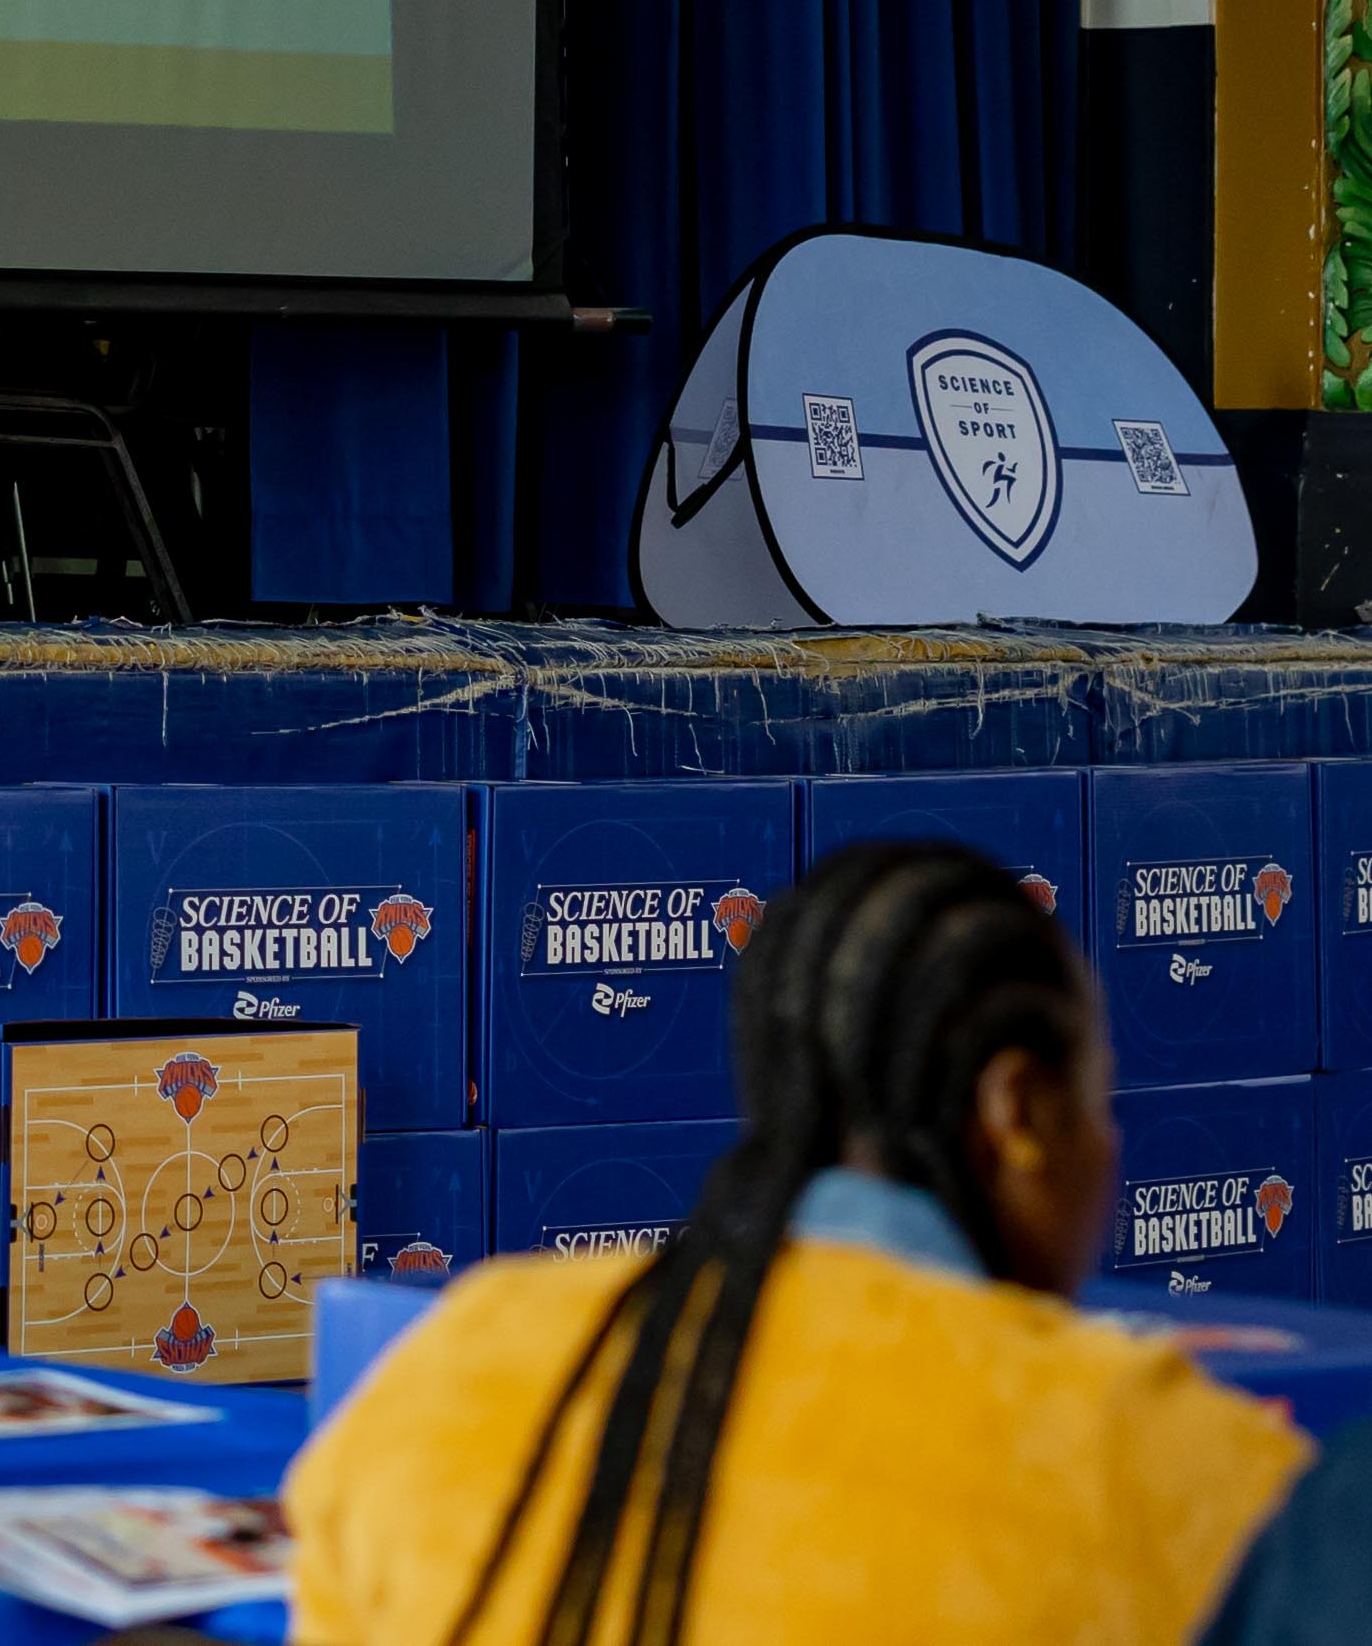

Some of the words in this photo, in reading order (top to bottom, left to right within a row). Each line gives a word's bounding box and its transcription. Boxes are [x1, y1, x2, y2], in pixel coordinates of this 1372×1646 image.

[938, 374, 1015, 396] SCIENCE
[973, 401, 991, 415] OF
[957, 419, 1017, 439] SPORT
[1133, 866, 1218, 897] SCIENCE
[1221, 863, 1248, 891] OF
[178, 895, 312, 927] SCIENCE
[318, 893, 361, 924] OF
[546, 889, 662, 923] SCIENCE
[667, 887, 704, 918] OF
[1134, 893, 1257, 937] BASKETBALL
[179, 926, 373, 972] BASKETBALL
[547, 920, 714, 965] BASKETBALL
[1186, 958, 1213, 986] Pfizer
[259, 997, 301, 1020] Pfizer
[614, 988, 652, 1018] Pfizer
[1133, 1181, 1219, 1216] SCIENCE
[1222, 1177, 1250, 1206] OF
[553, 1227, 671, 1264] SCIENCE
[1133, 1206, 1257, 1256] BASKETBALL
